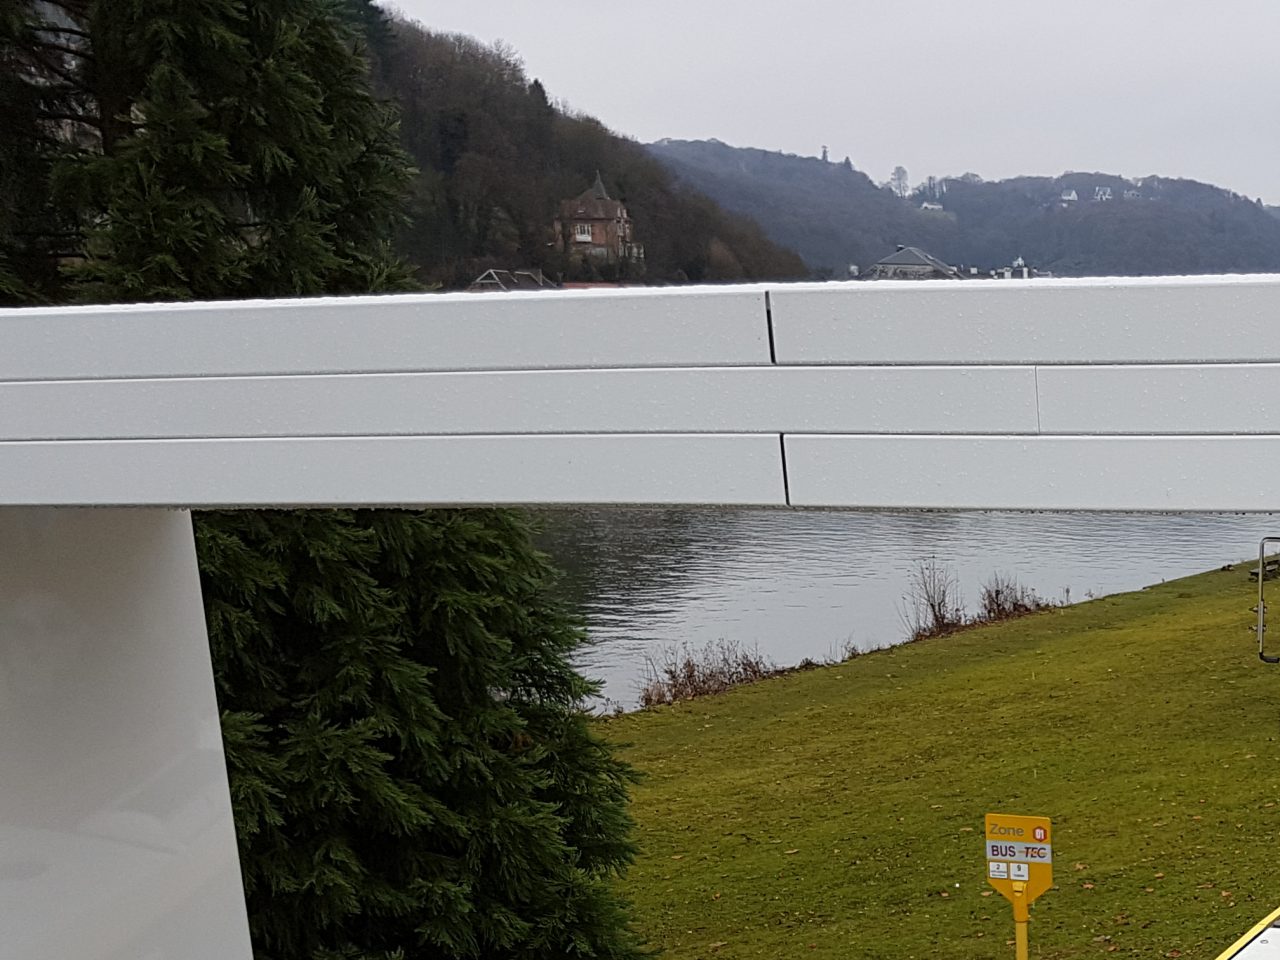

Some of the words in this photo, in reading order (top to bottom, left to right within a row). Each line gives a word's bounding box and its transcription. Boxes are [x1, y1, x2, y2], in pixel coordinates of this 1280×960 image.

[990, 823, 1024, 837] Zone
[991, 845, 1016, 857] BUS
[1024, 846, 1047, 859] TEC
